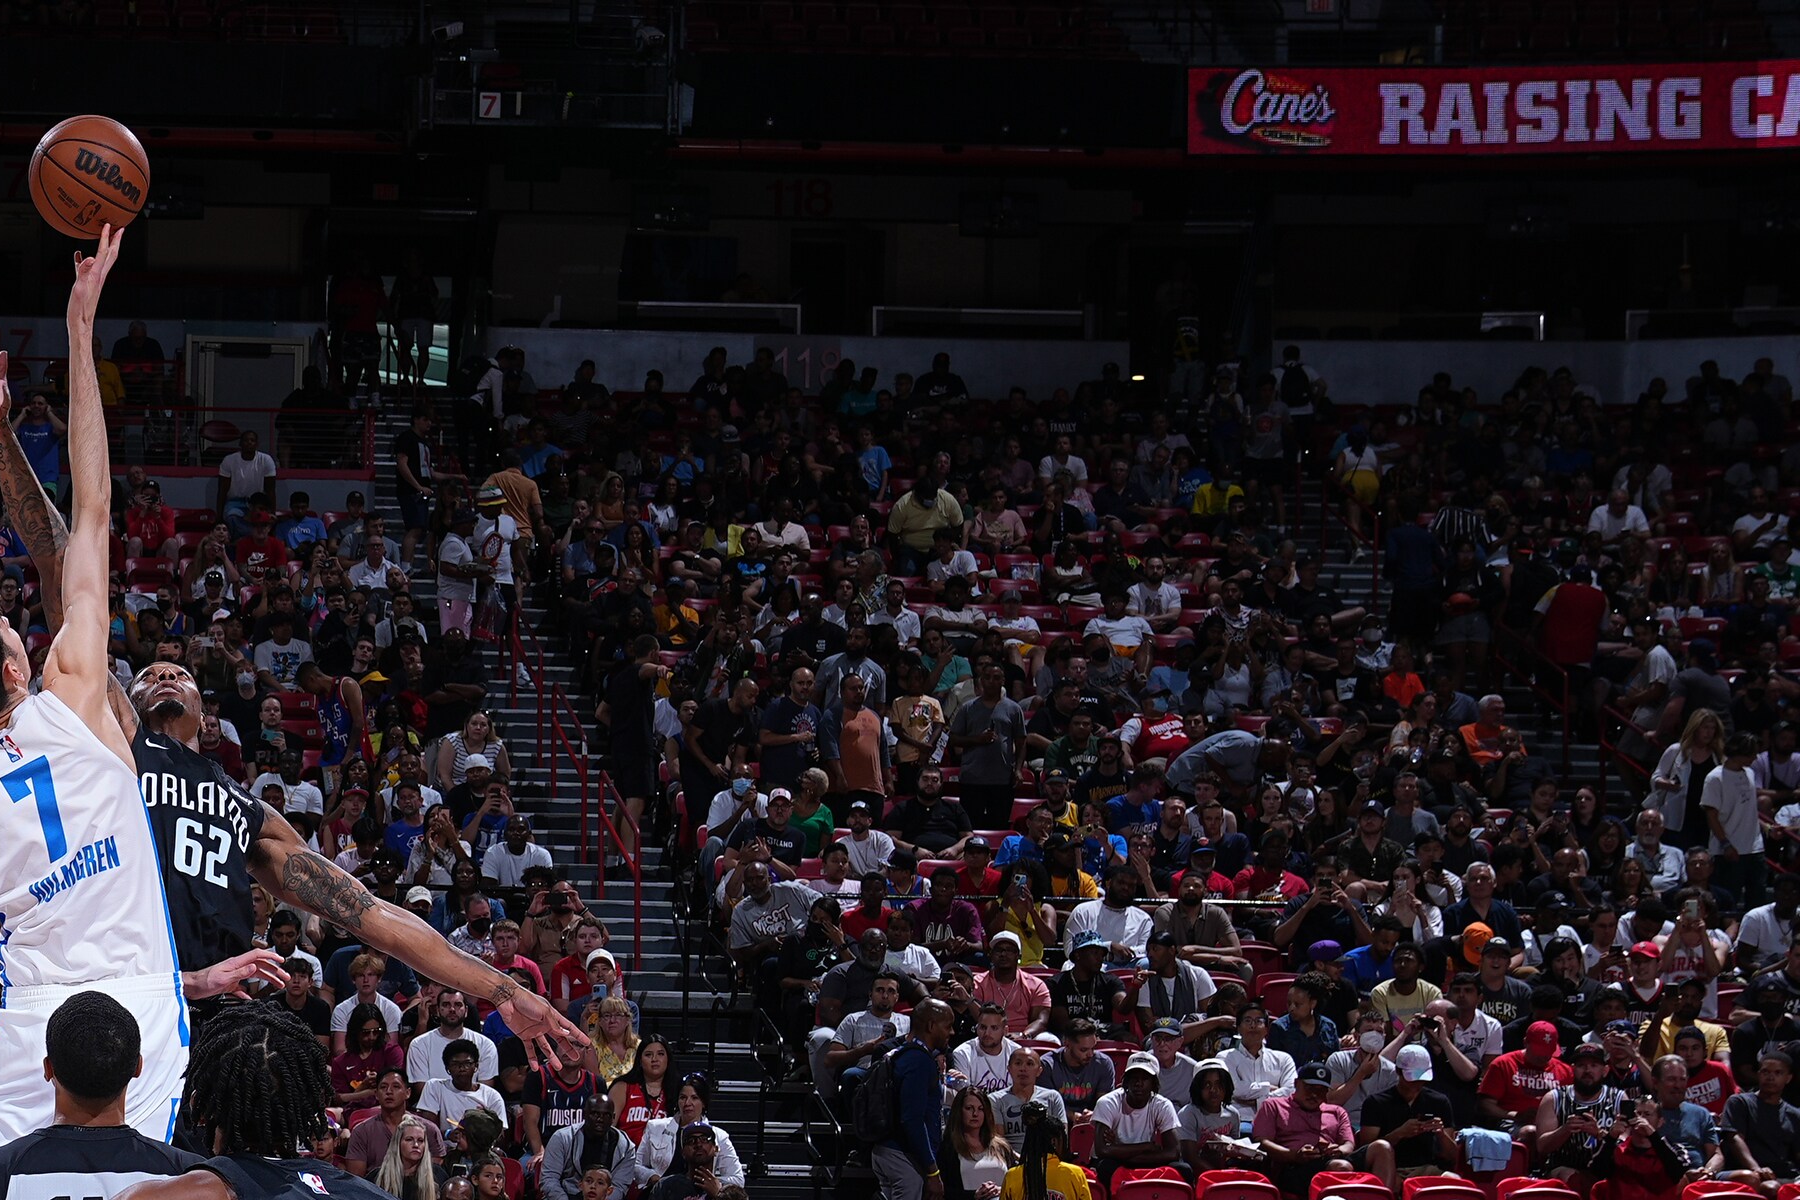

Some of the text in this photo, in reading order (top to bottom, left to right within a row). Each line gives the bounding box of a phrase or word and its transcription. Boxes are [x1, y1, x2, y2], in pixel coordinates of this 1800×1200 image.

[482, 95, 497, 116] 7
[1221, 68, 1336, 134] Cane's
[1378, 79, 1703, 146] RAISING
[75, 148, 140, 205] Wilson
[766, 179, 833, 217] 118
[0, 755, 68, 864] 7
[141, 772, 250, 854] ORLANDO
[29, 835, 121, 905] HOLMGREN
[173, 817, 232, 889] 62
[1481, 1000, 1517, 1019] AKERS
